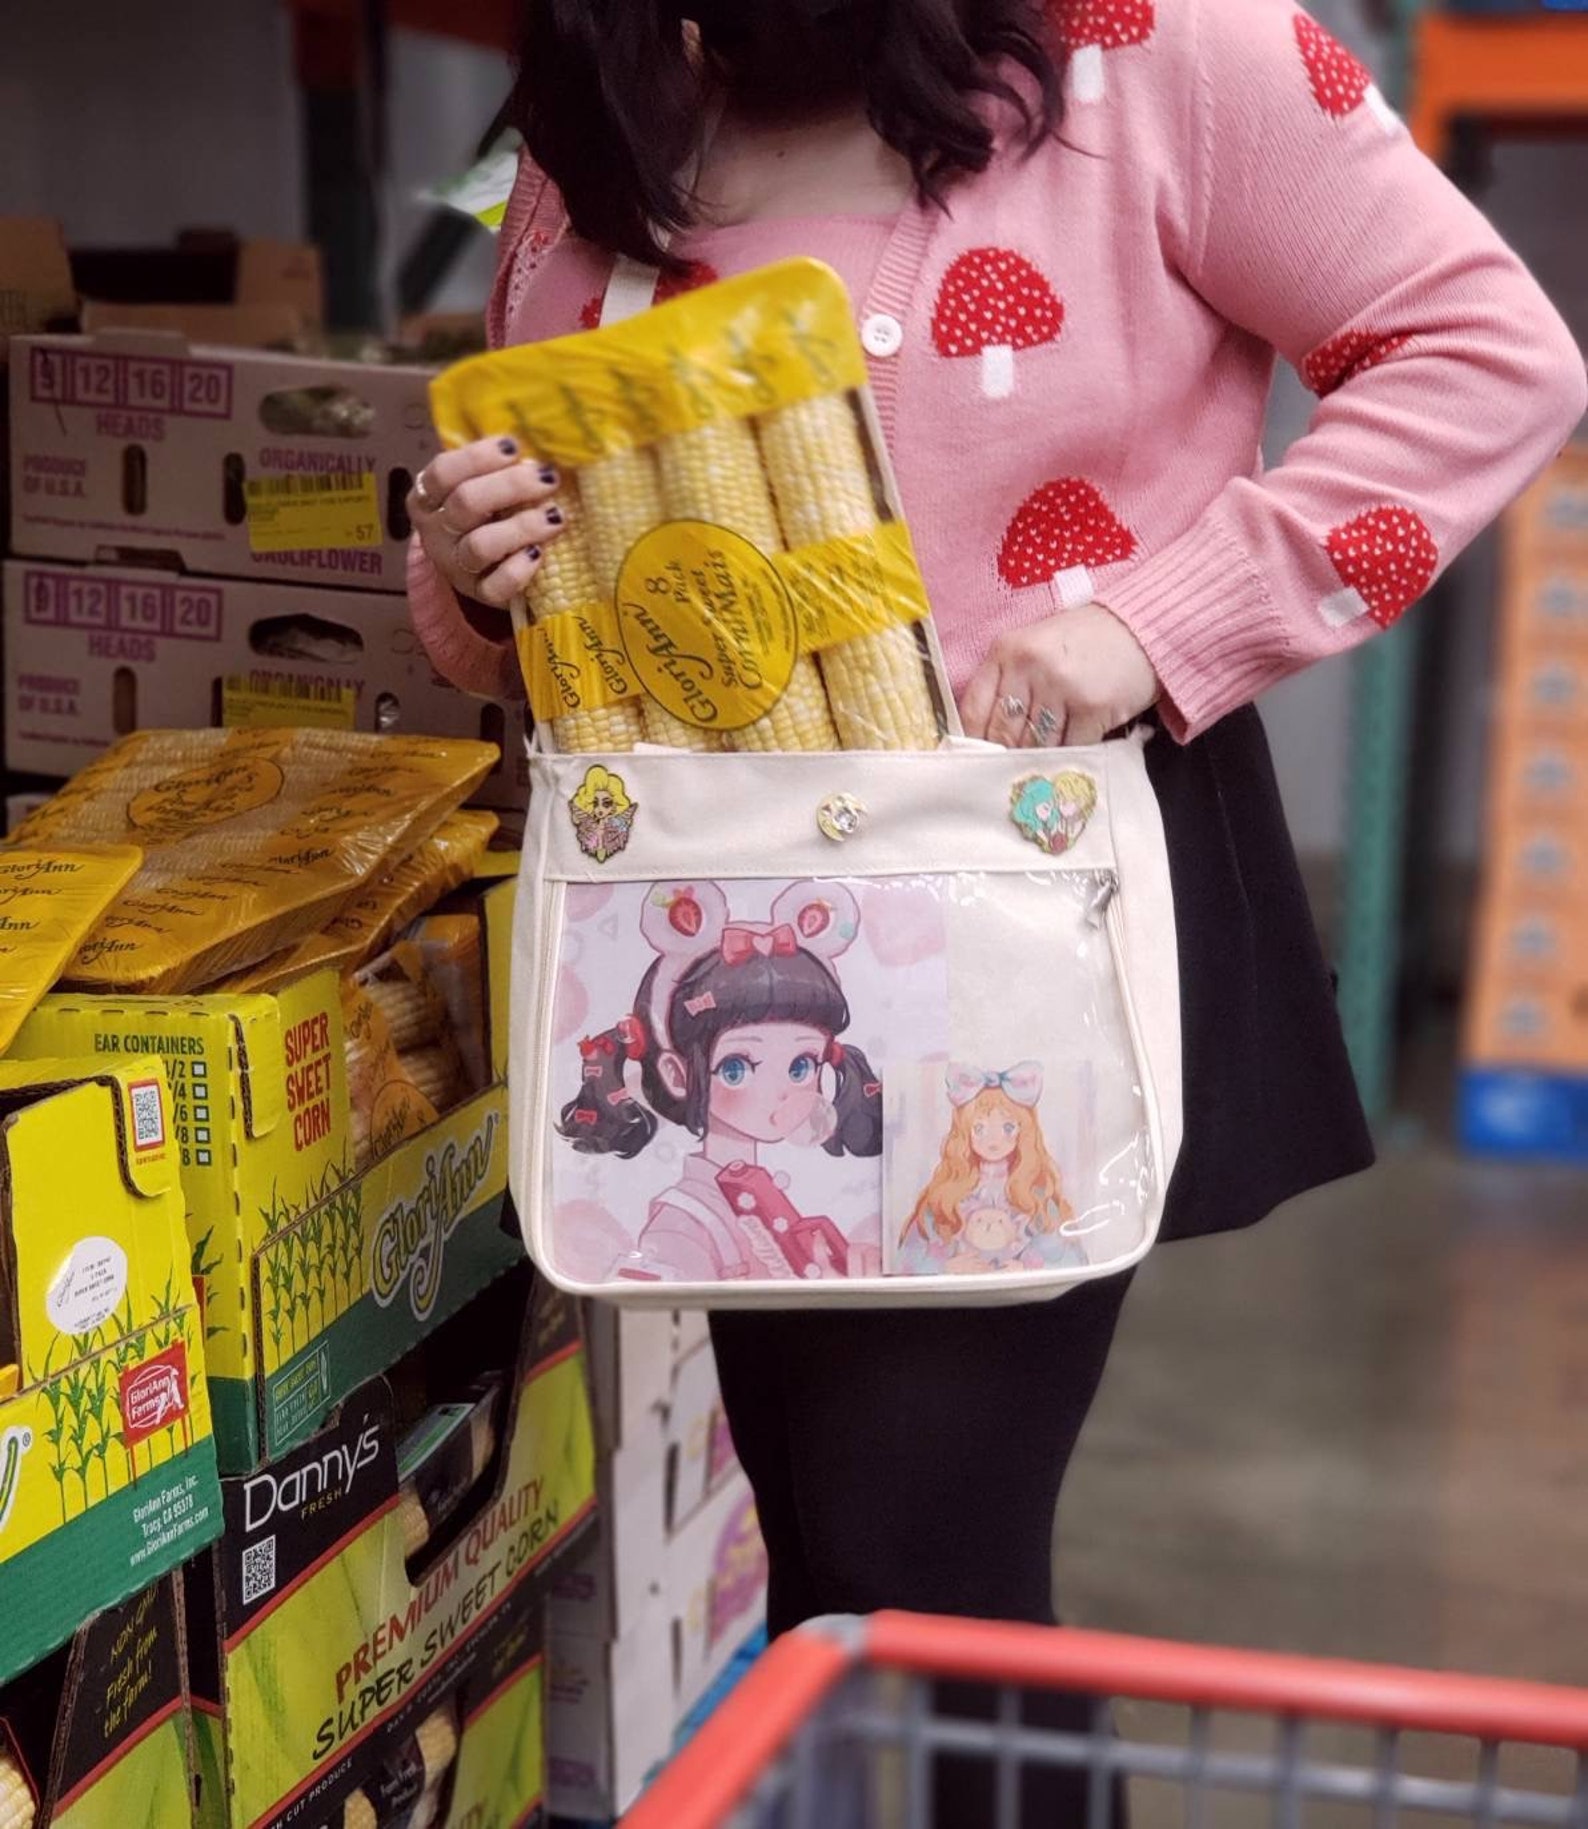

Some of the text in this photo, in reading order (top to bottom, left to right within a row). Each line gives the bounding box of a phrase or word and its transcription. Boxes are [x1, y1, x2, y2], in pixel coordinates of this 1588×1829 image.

[79, 363, 112, 394] 12
[132, 367, 166, 400] 16
[189, 371, 222, 405] 20
[96, 412, 167, 442] HEADS
[259, 447, 377, 475] ORGANICALLY
[71, 586, 103, 618] 12
[126, 591, 158, 623] 16
[180, 597, 213, 628] 20
[645, 575, 670, 595] 8
[87, 632, 157, 662] HEADS
[711, 631, 739, 689] Super
[95, 1034, 205, 1056] EAR CONTAINERS
[284, 1010, 330, 1068] SUPER
[168, 1081, 186, 1102] /4
[286, 1051, 331, 1113] SWEET
[294, 1097, 331, 1152] CORN
[371, 1112, 495, 1319] GloriAnn
[243, 1412, 380, 1533] Danny's
[301, 1487, 342, 1521] FRESH
[335, 1551, 460, 1706] PREMIUM
[464, 1474, 545, 1567] QUALITY
[312, 1657, 415, 1762] SUPER
[420, 1559, 502, 1669] SWEET
[505, 1497, 559, 1578] CORN
[286, 1799, 306, 1822] CUT
[308, 1756, 353, 1802] PRODUCE
